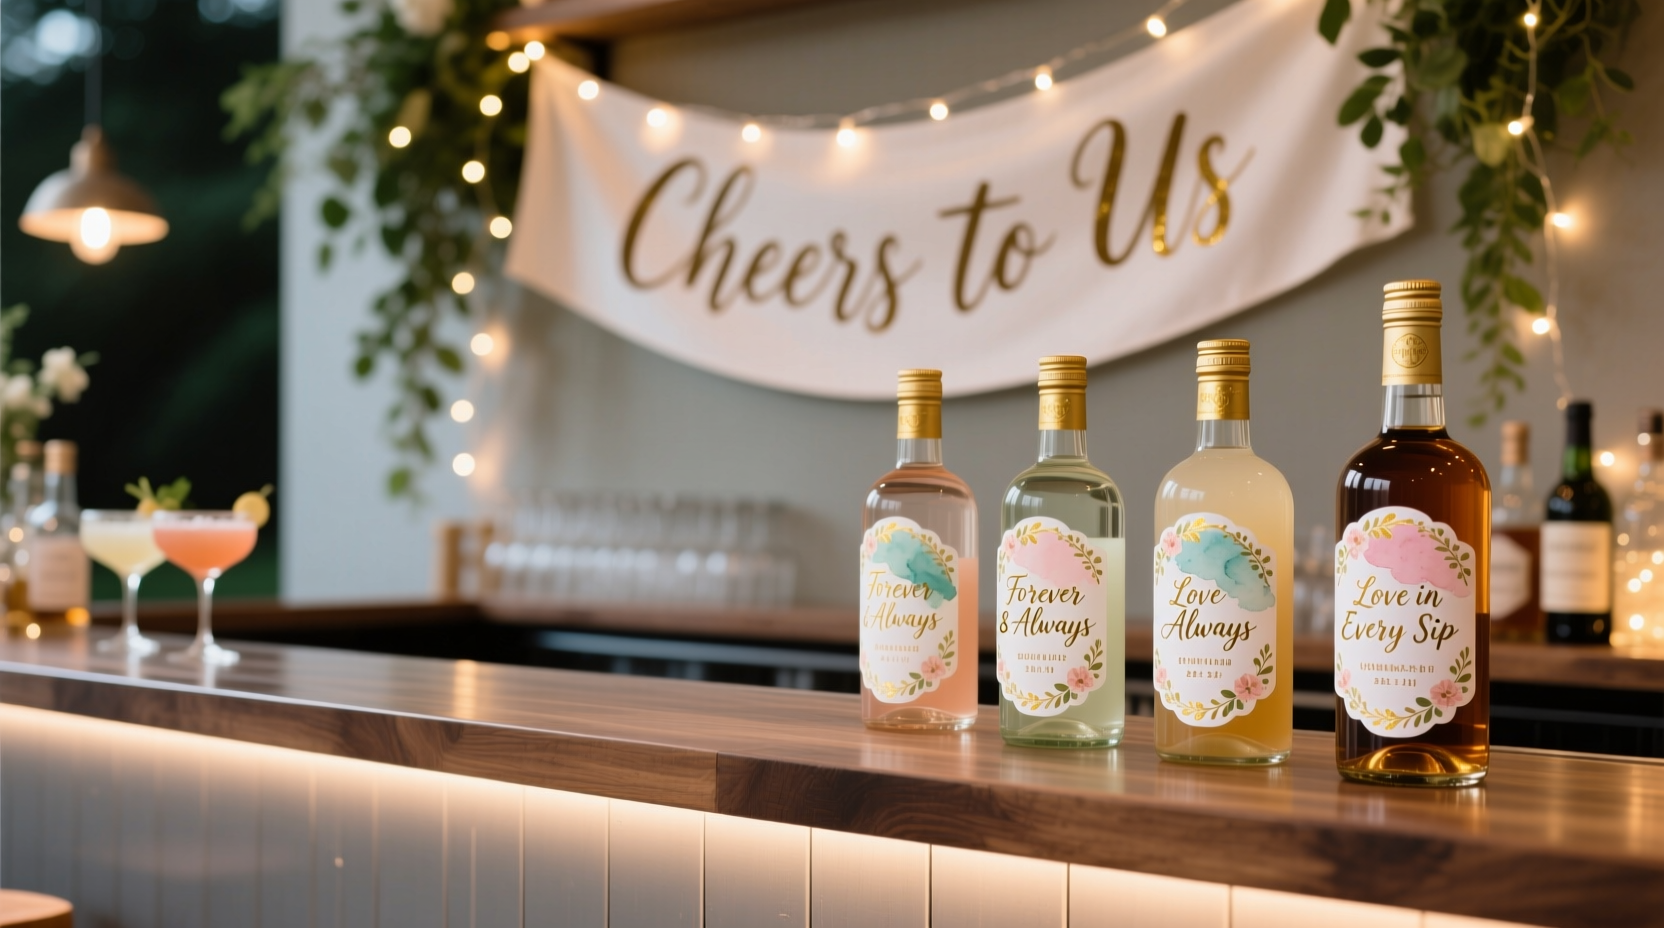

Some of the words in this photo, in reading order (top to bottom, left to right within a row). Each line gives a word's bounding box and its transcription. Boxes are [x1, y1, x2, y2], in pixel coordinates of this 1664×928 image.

[619, 155, 921, 333] Cheers
[938, 181, 1057, 312] to
[1068, 112, 1255, 266] Us
[867, 569, 933, 601] Forever
[1006, 573, 1085, 606] Forever
[1168, 576, 1227, 608] Love
[1353, 575, 1410, 608] Love
[1416, 584, 1443, 608] in
[870, 602, 944, 640] Always
[1011, 606, 1097, 648] Always
[1161, 608, 1257, 652] Always
[1341, 610, 1406, 653] Every
[1413, 613, 1459, 650] Sip
